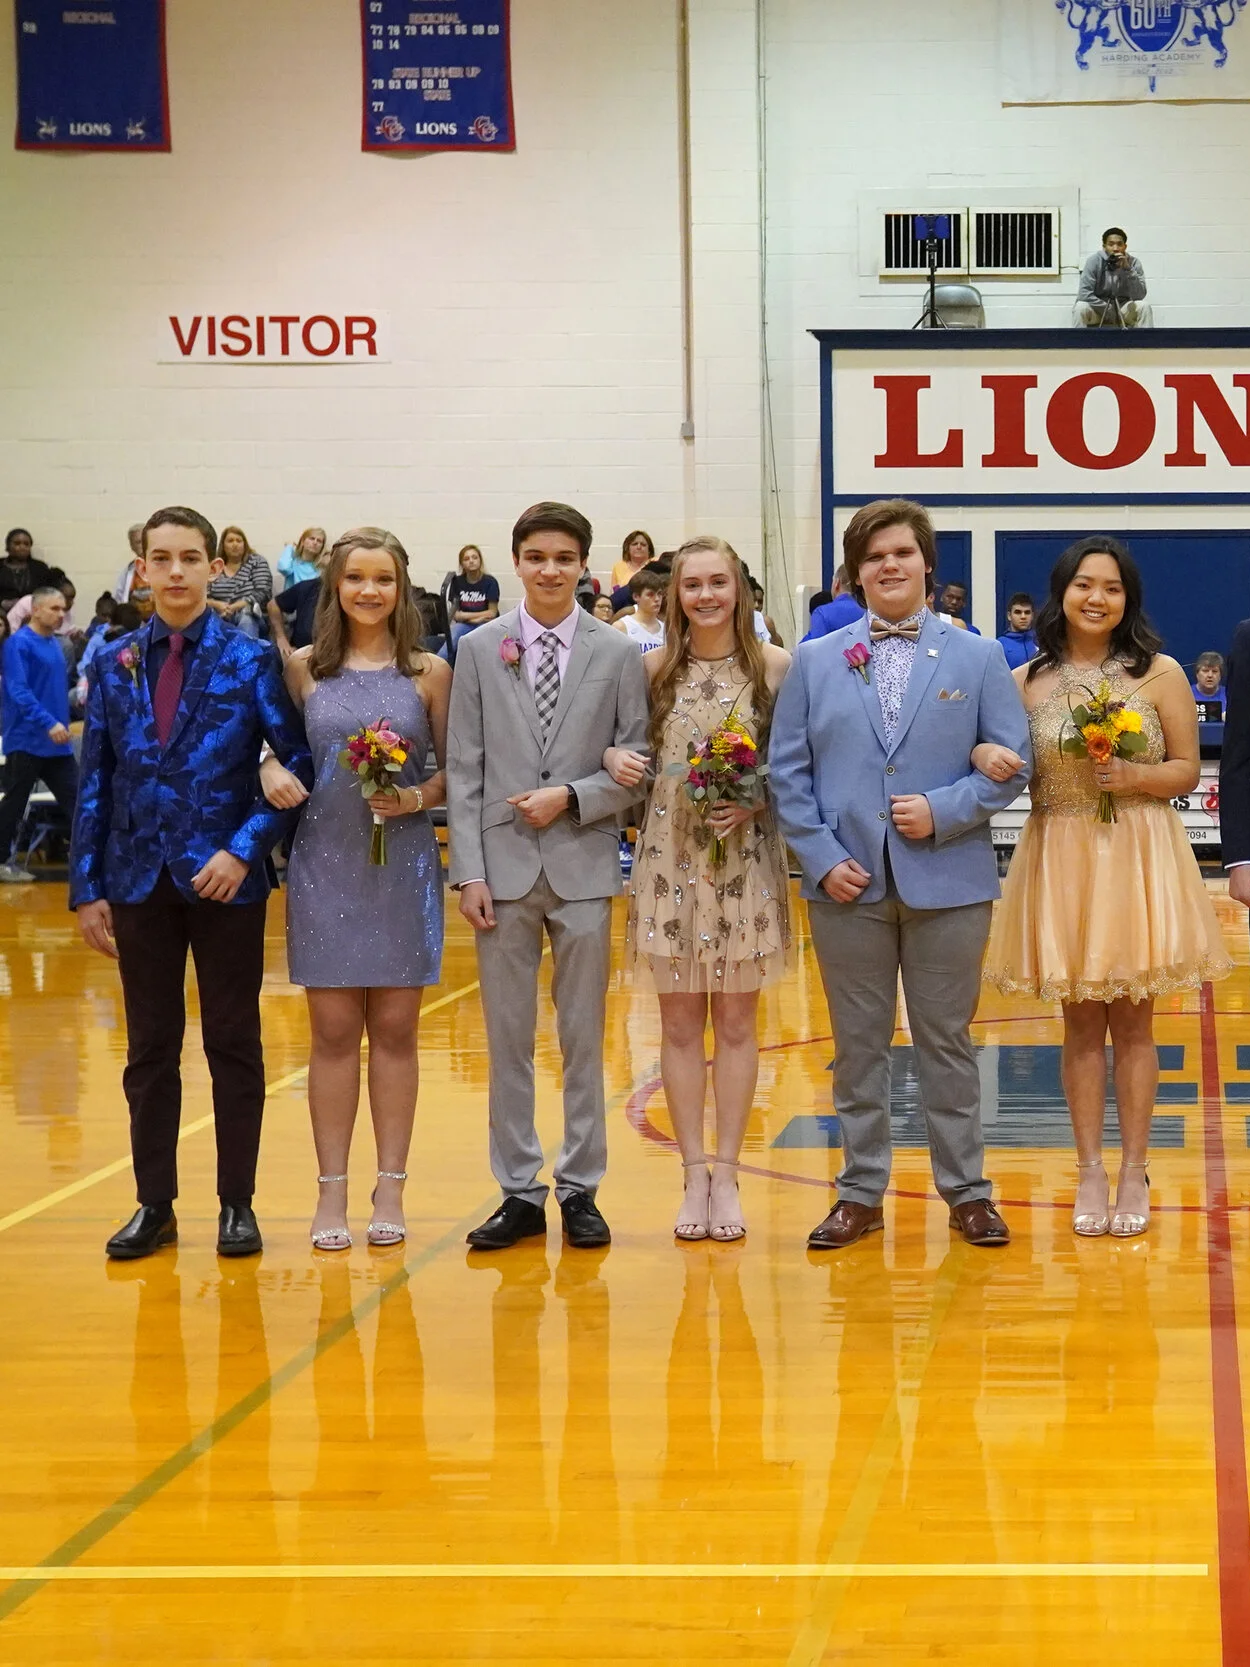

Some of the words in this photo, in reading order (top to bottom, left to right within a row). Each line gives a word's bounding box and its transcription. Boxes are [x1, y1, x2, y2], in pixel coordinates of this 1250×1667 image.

[1102, 54, 1148, 63] HARDING
[1152, 53, 1201, 62] ACADEMY
[69, 122, 112, 136] LIONS
[416, 122, 457, 135] LIONS
[169, 315, 378, 357] VISITOR
